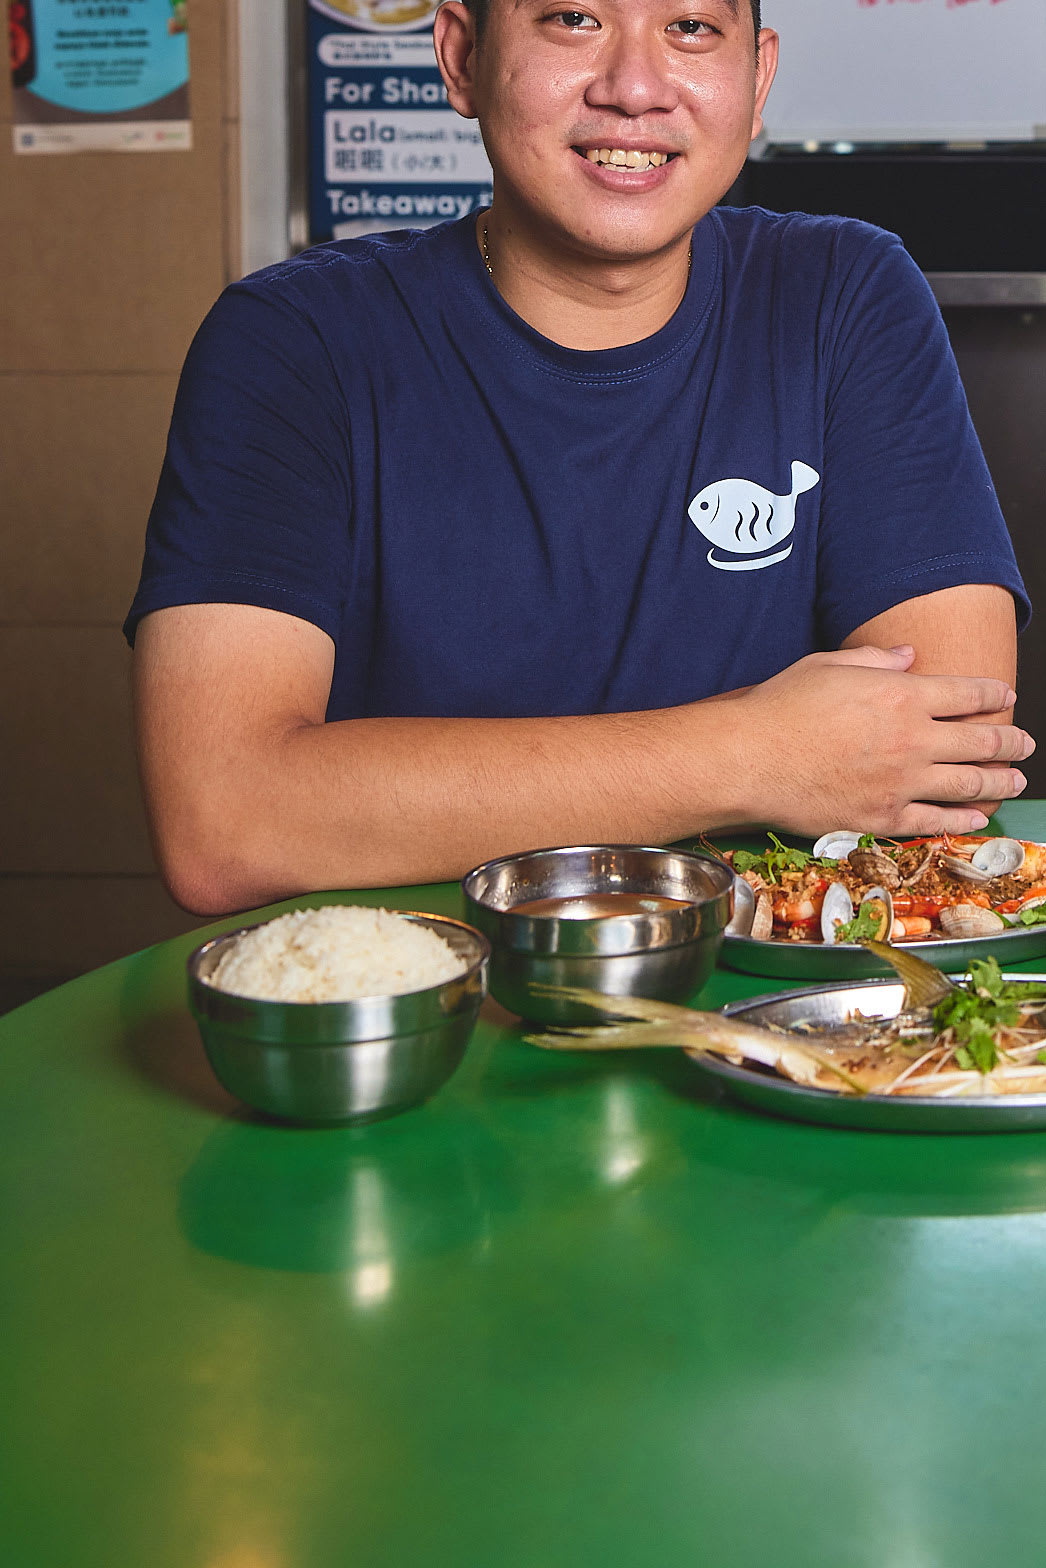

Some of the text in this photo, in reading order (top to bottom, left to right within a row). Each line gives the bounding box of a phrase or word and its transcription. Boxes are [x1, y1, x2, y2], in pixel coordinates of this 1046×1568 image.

[324, 76, 375, 103] For
[332, 118, 396, 144] Lala
[326, 189, 474, 219] Takeaway
